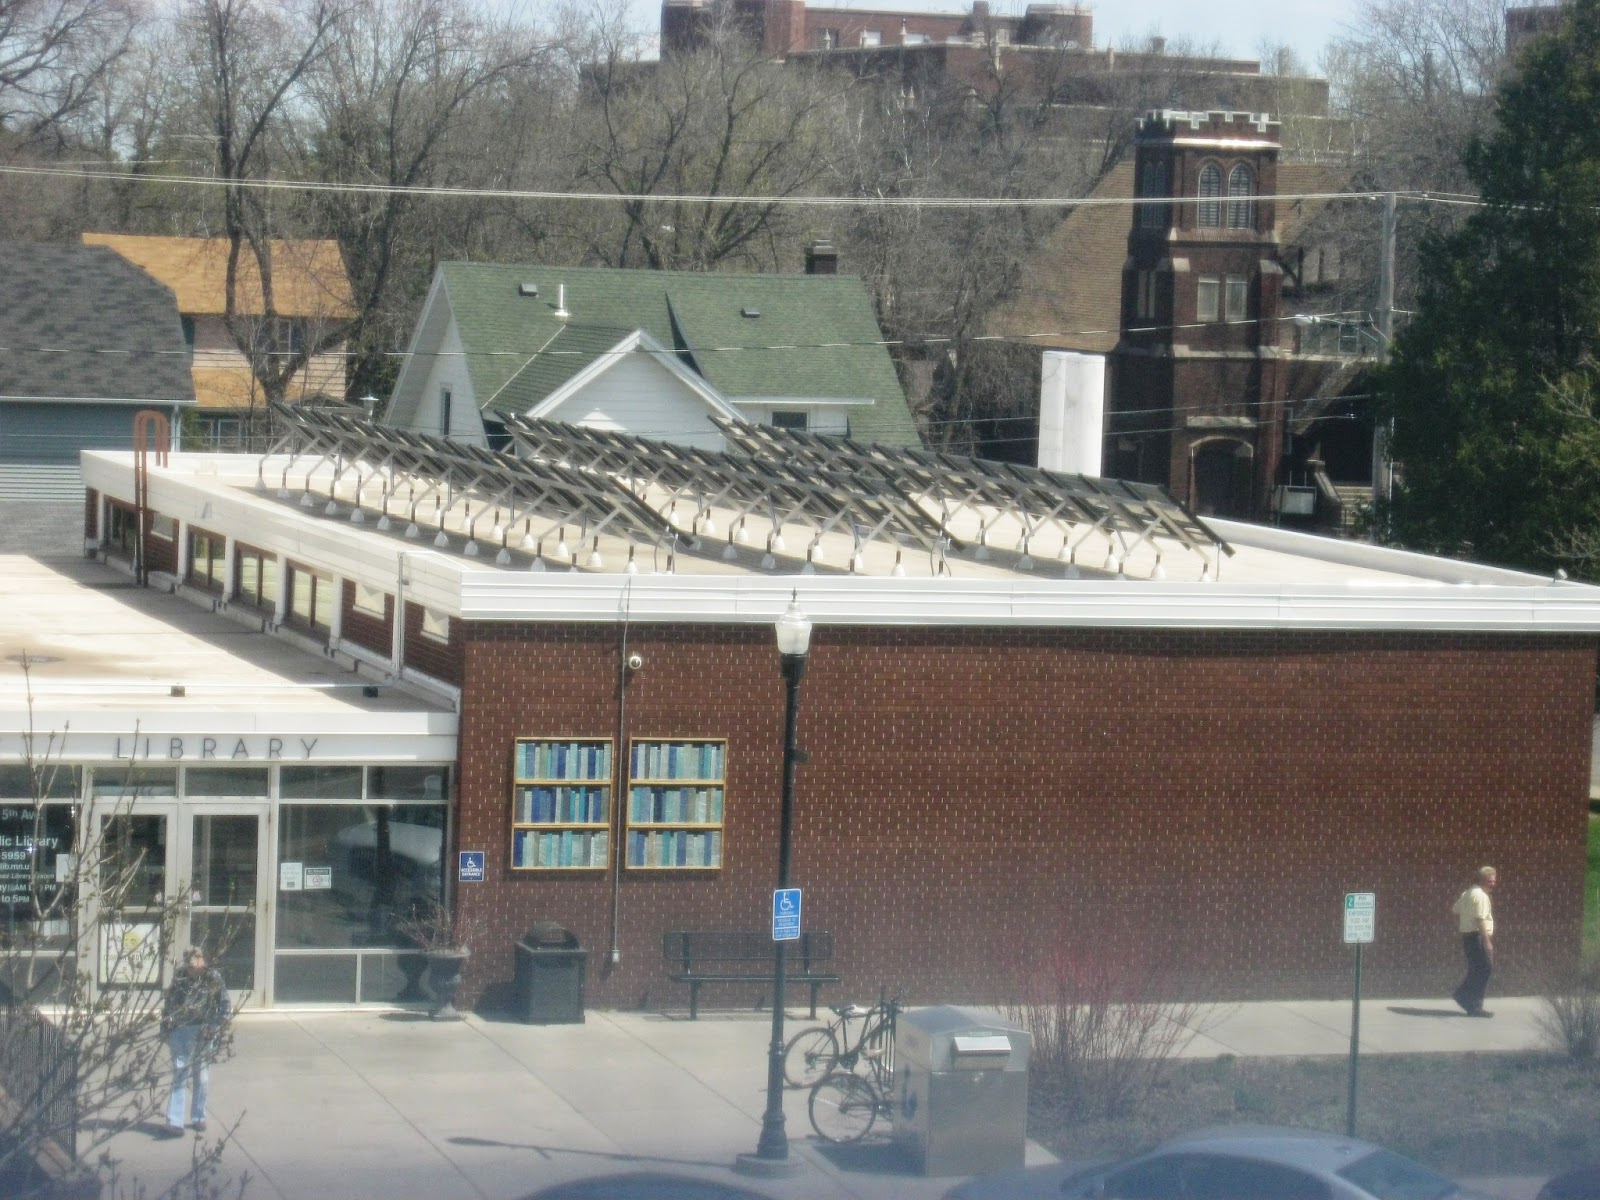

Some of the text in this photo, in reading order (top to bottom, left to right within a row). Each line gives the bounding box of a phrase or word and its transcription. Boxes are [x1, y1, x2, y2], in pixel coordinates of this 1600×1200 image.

[116, 737, 318, 759] LIBRARY
[2, 809, 17, 820] 5th
[16, 835, 58, 849] Library
[1348, 896, 1354, 907] 2
